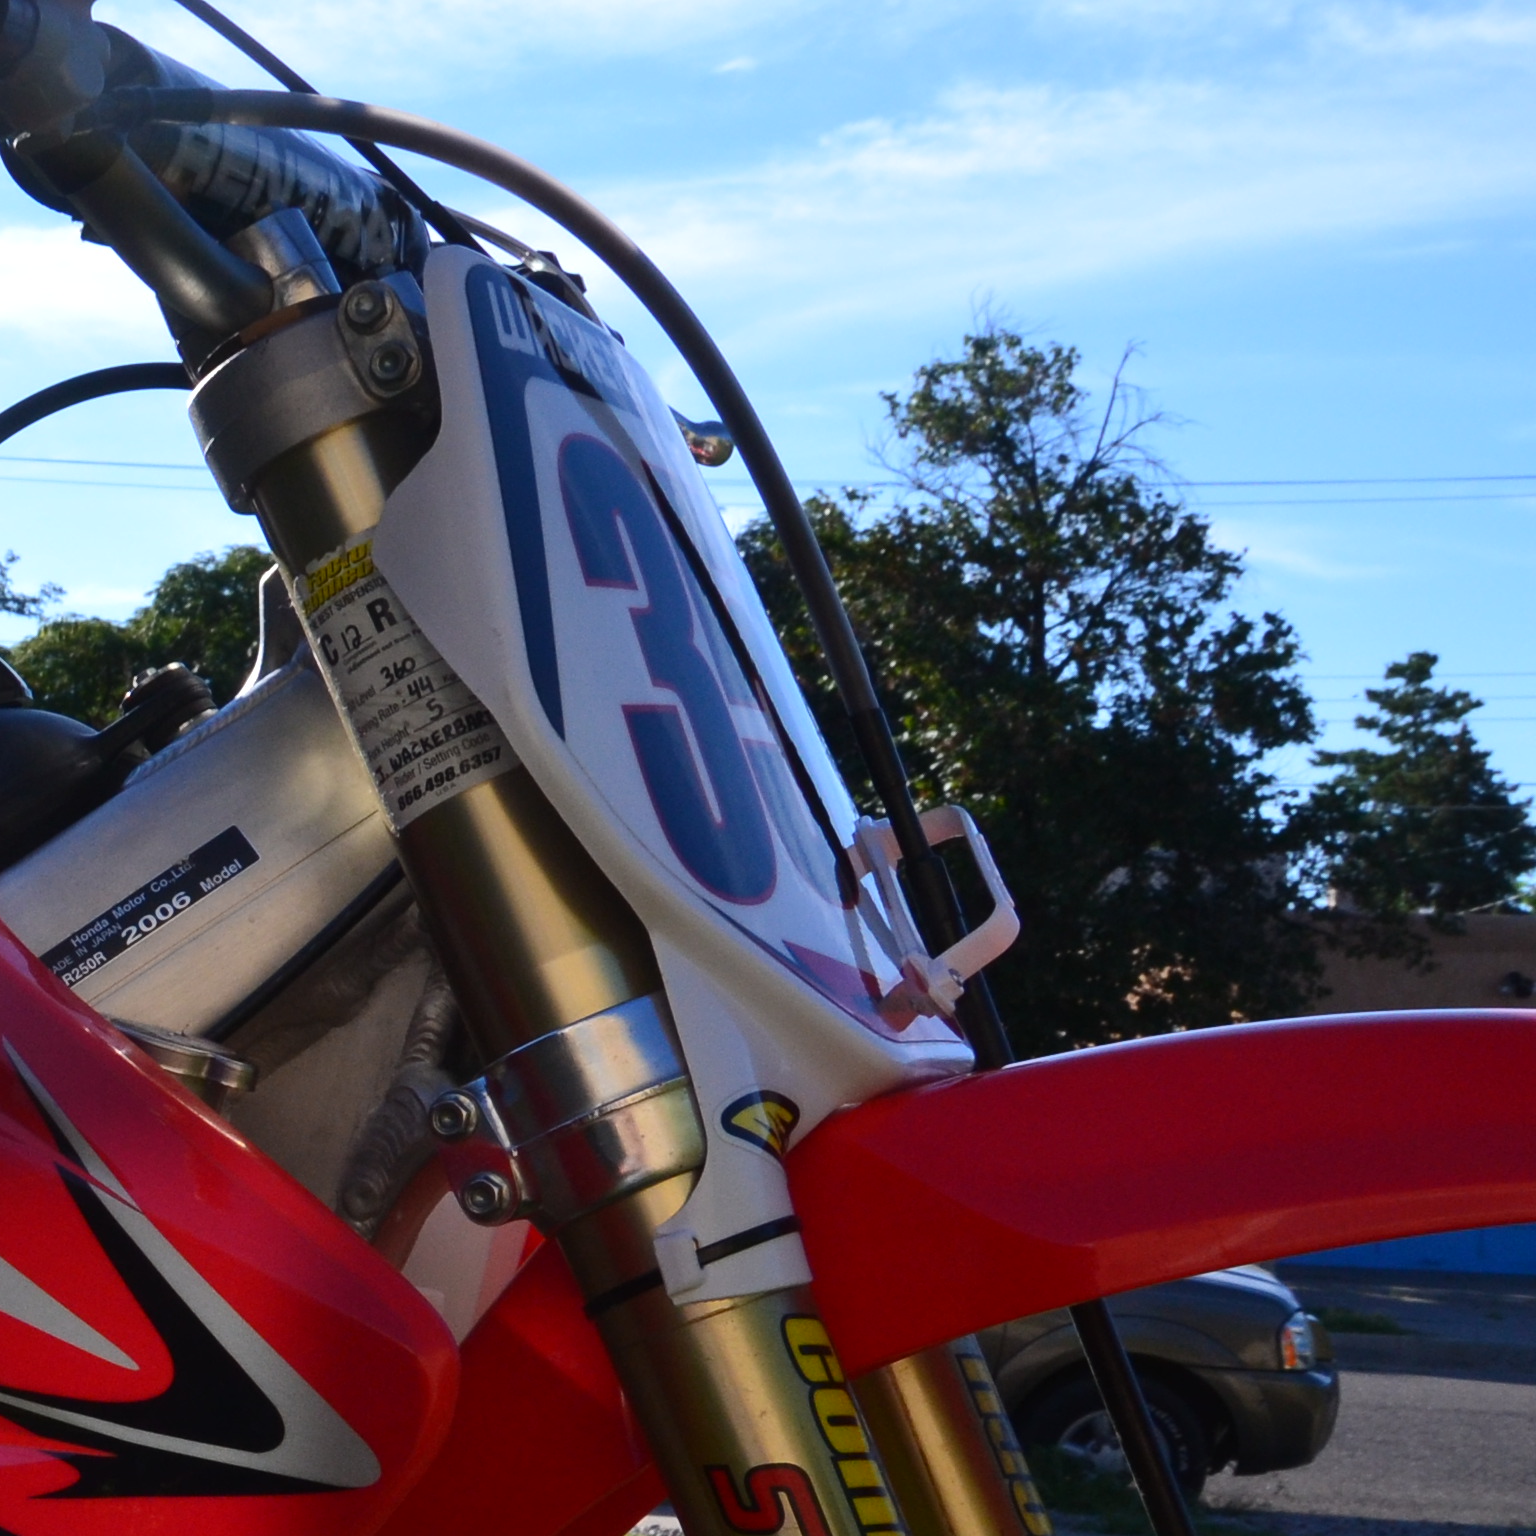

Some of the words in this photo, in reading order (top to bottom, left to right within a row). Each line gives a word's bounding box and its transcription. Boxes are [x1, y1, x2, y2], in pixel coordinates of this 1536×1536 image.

[336, 576, 387, 613] SUSPENSIO
[380, 656, 416, 689] 360
[377, 701, 400, 724] Rate
[389, 710, 496, 775] WACKERBART
[424, 743, 462, 774] Setting
[462, 730, 491, 754] Code
[62, 951, 108, 987] R250R
[121, 890, 192, 946] 2006
[199, 858, 244, 893] Model
[70, 918, 110, 948] Honda
[112, 892, 147, 920] Motor
[91, 921, 124, 949] JAPAN
